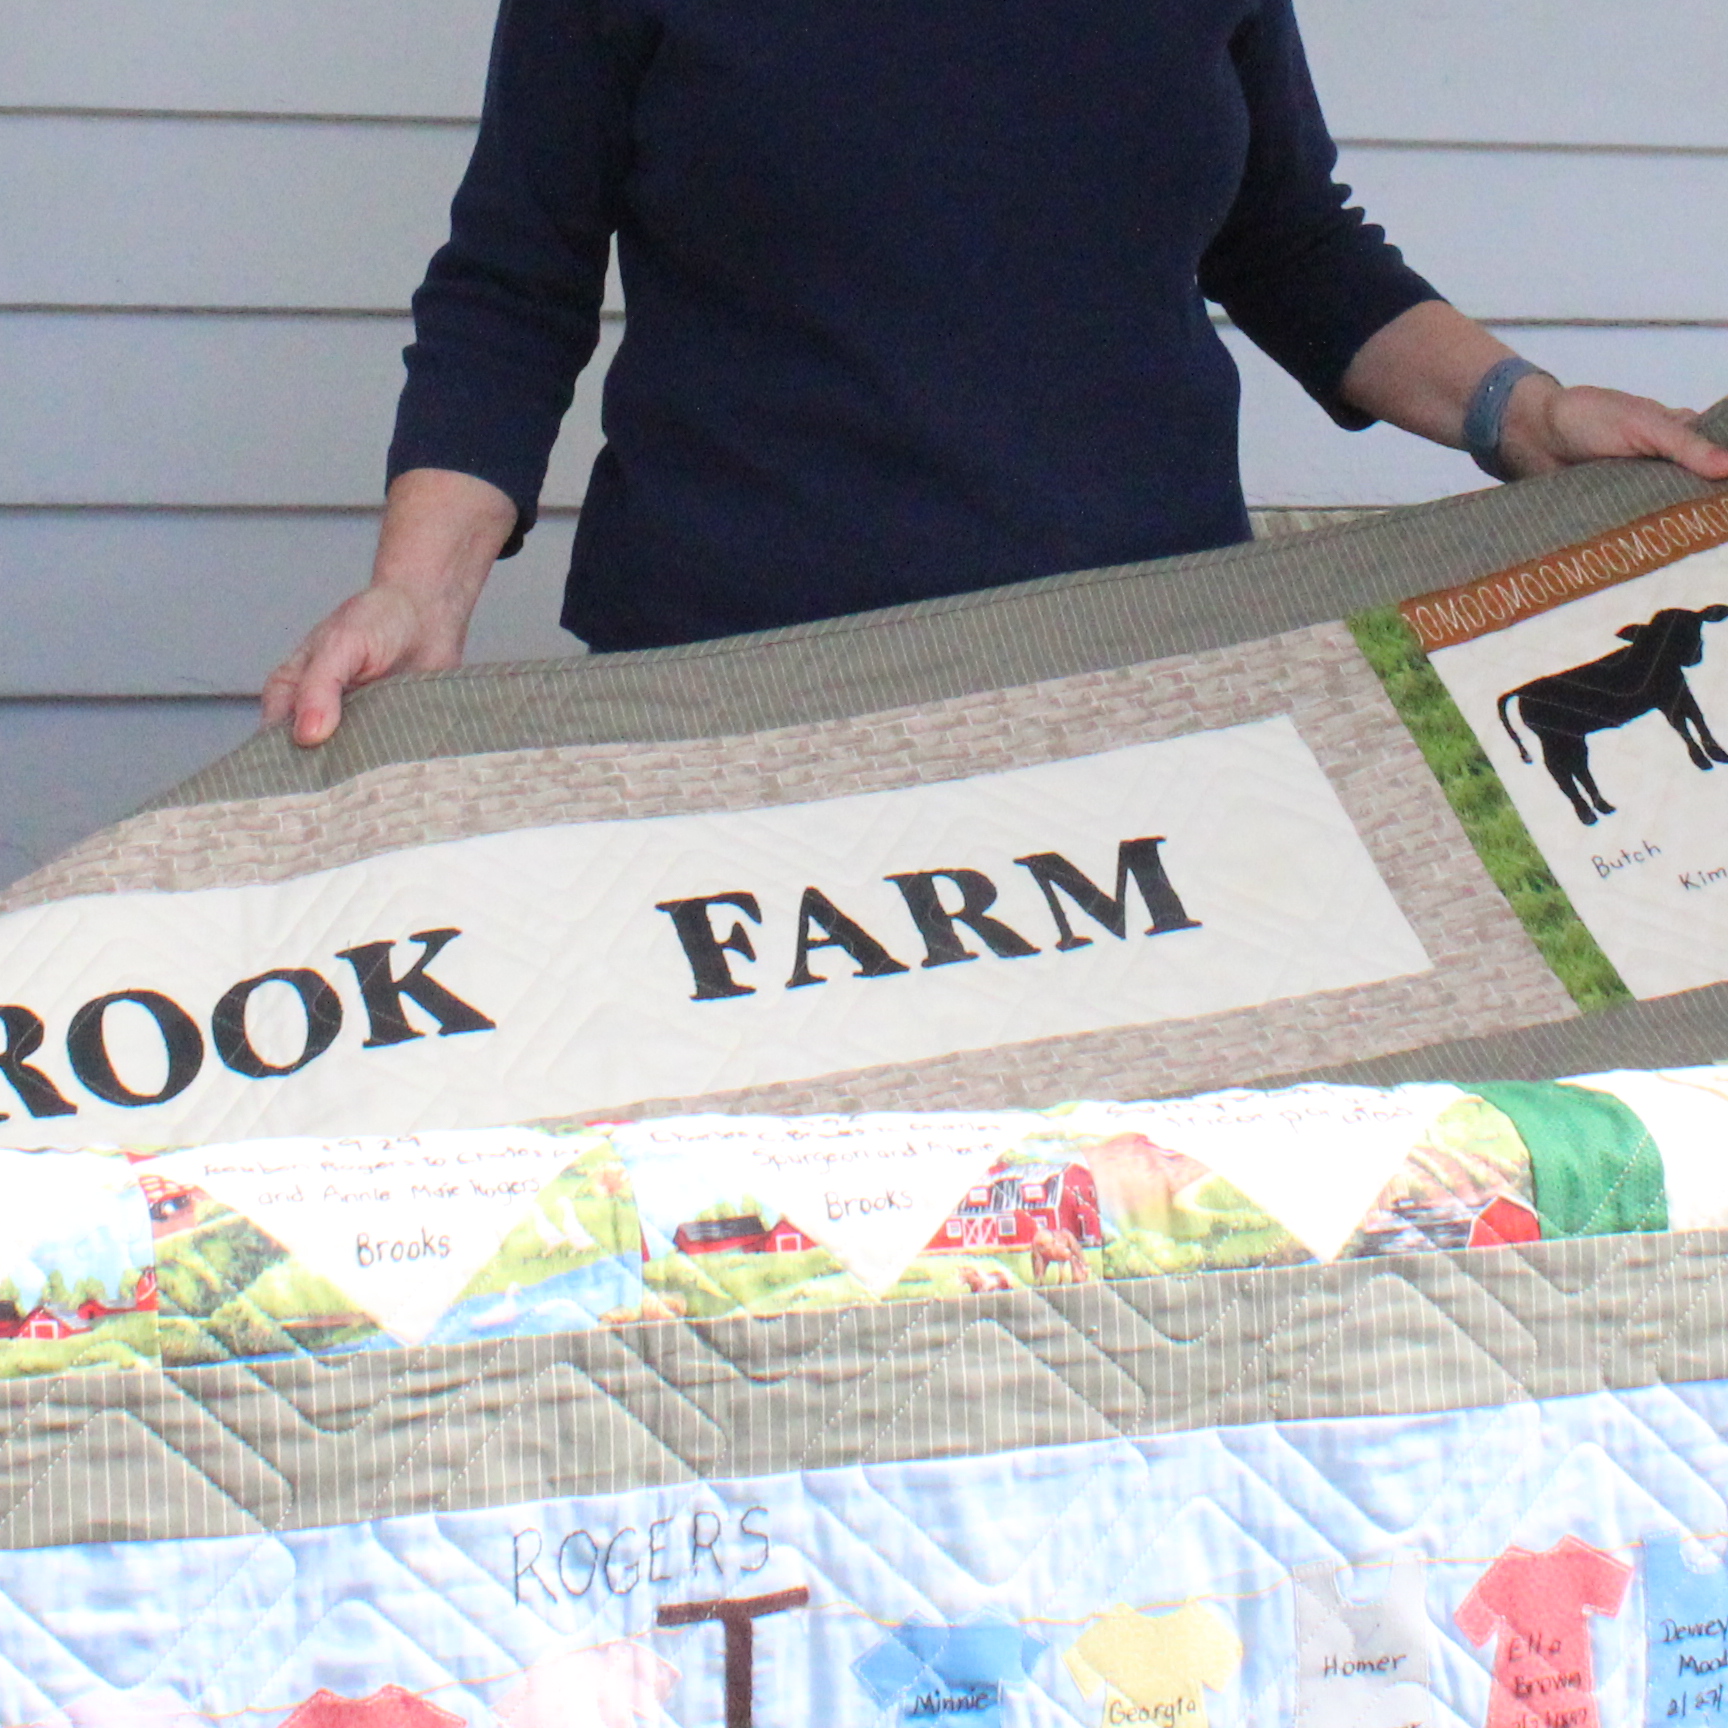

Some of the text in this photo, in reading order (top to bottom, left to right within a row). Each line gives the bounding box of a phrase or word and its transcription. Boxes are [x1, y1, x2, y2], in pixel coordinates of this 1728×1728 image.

[1591, 839, 1662, 879] Butch
[657, 838, 1200, 1000] FARM
[752, 1147, 870, 1176] Spurgeon
[877, 1141, 918, 1159] and
[258, 1184, 305, 1206] and
[469, 1177, 541, 1207] Rogers
[822, 1187, 914, 1222] Brooks
[356, 1225, 452, 1269] Brooks
[512, 1503, 771, 1608] ROGERS
[1323, 1652, 1408, 1678] Homer
[912, 1686, 990, 1717] Minnie
[1108, 1695, 1197, 1728] Georgia
